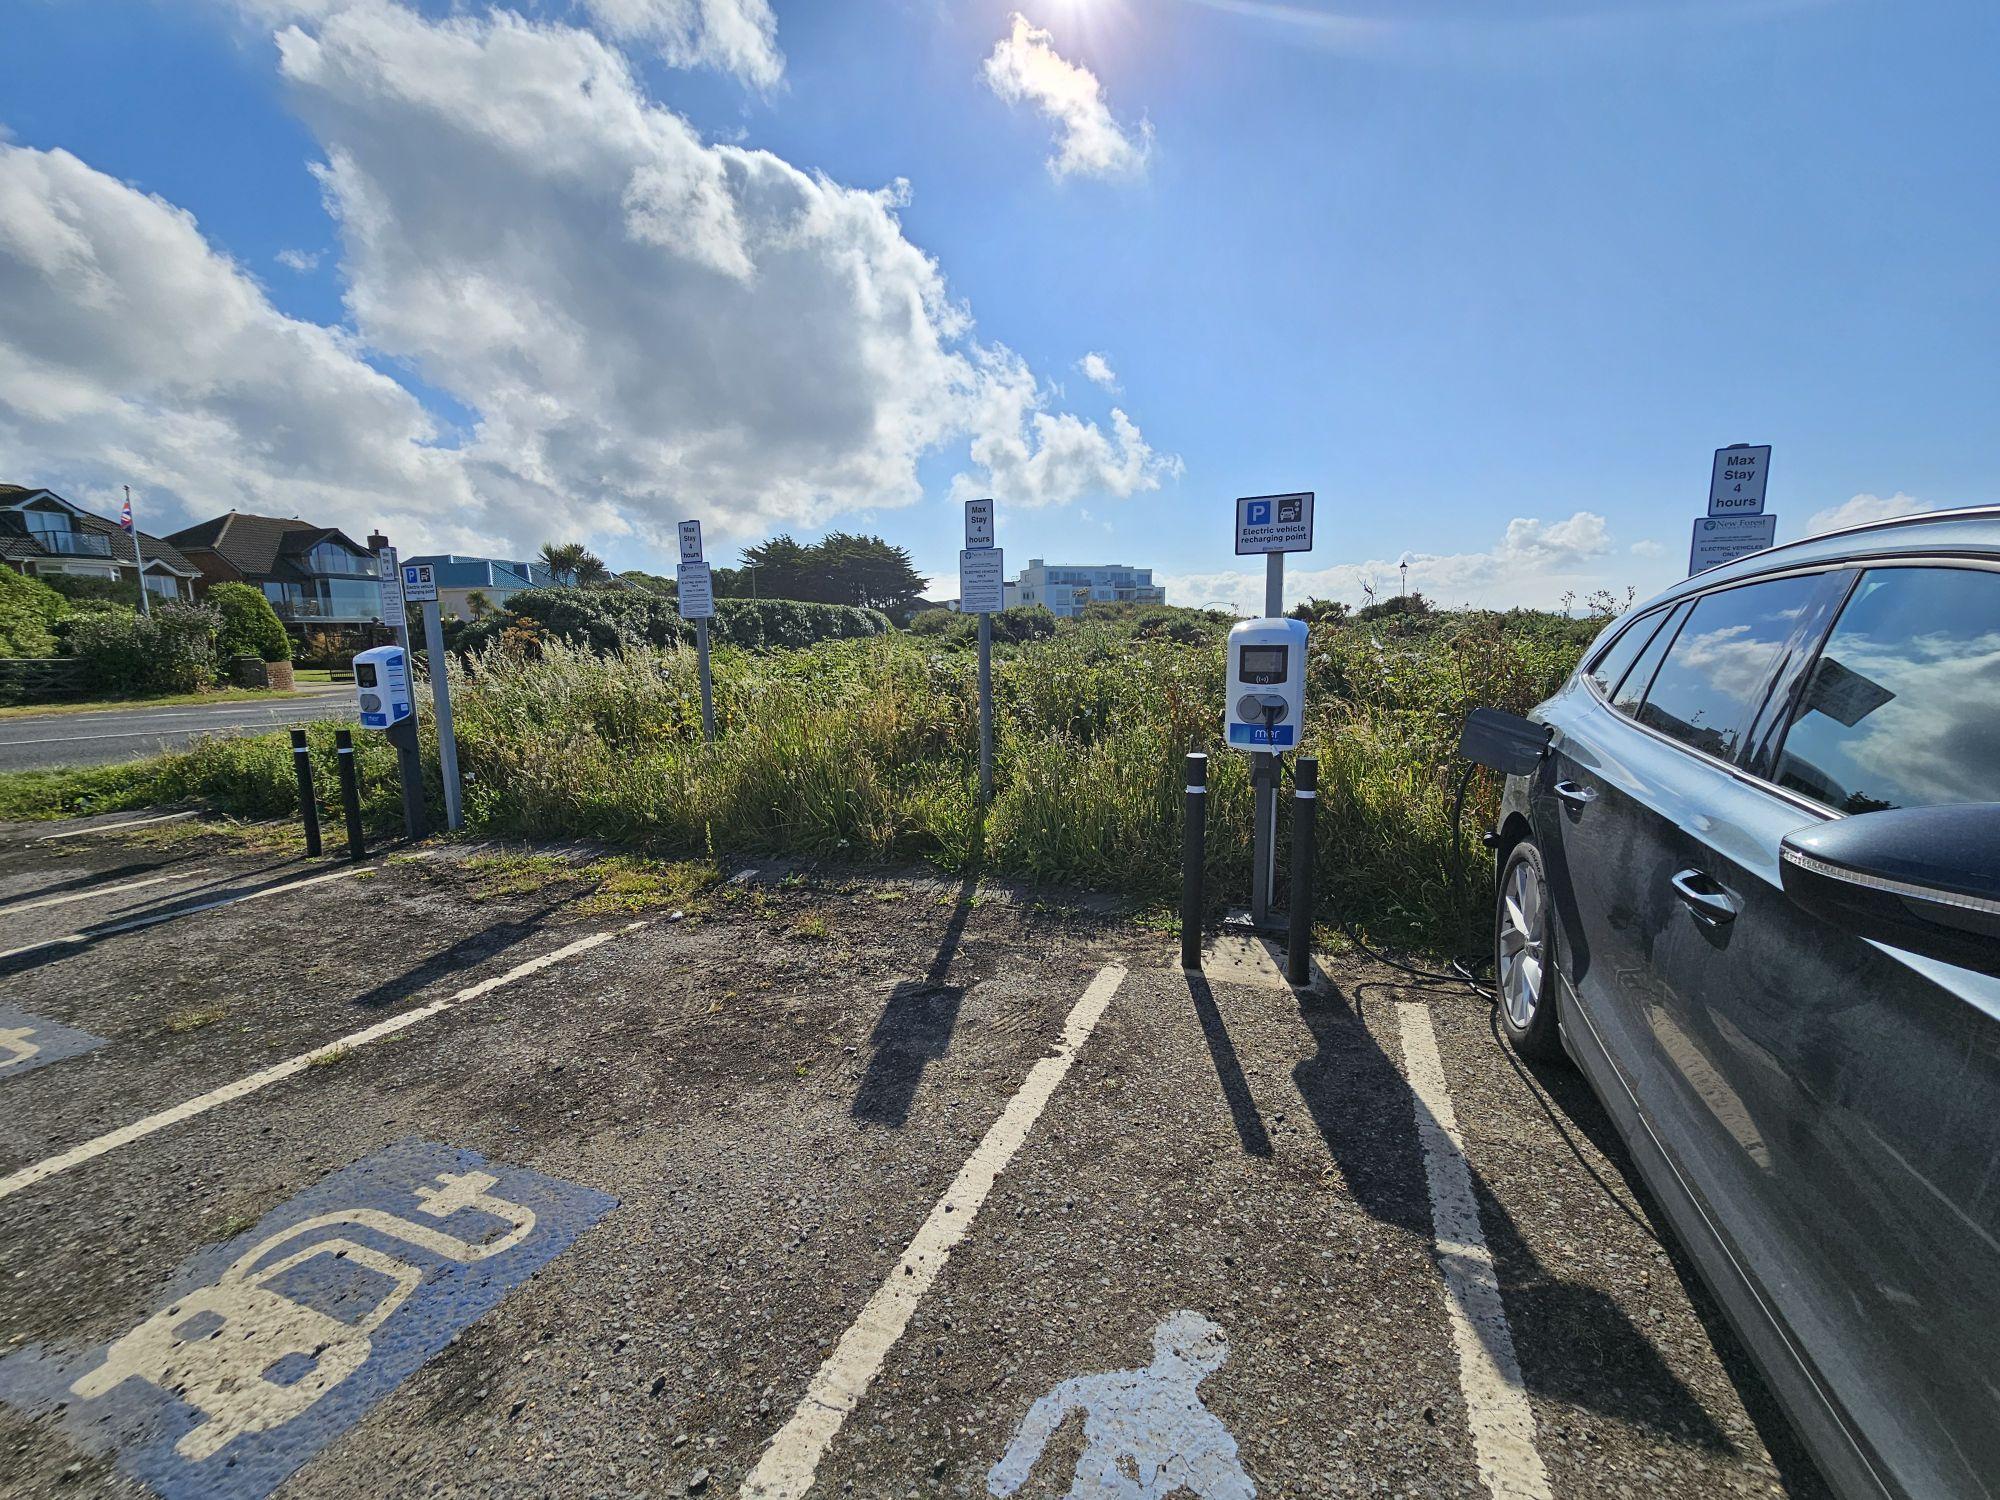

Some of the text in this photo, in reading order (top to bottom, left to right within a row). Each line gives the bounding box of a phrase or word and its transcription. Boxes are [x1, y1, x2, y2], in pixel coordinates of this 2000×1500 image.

[1727, 456, 1756, 466] Max
[1723, 470, 1756, 482] Stay
[1733, 484, 1741, 493] 4
[1716, 498, 1757, 508] hours
[971, 506, 987, 514] Max
[1252, 505, 1265, 521] P
[971, 516, 988, 525] Stay
[1740, 518, 1766, 526] Forest
[1243, 525, 1306, 535] Electric vehicle
[1241, 533, 1307, 544] recharging point
[408, 571, 414, 581] P
